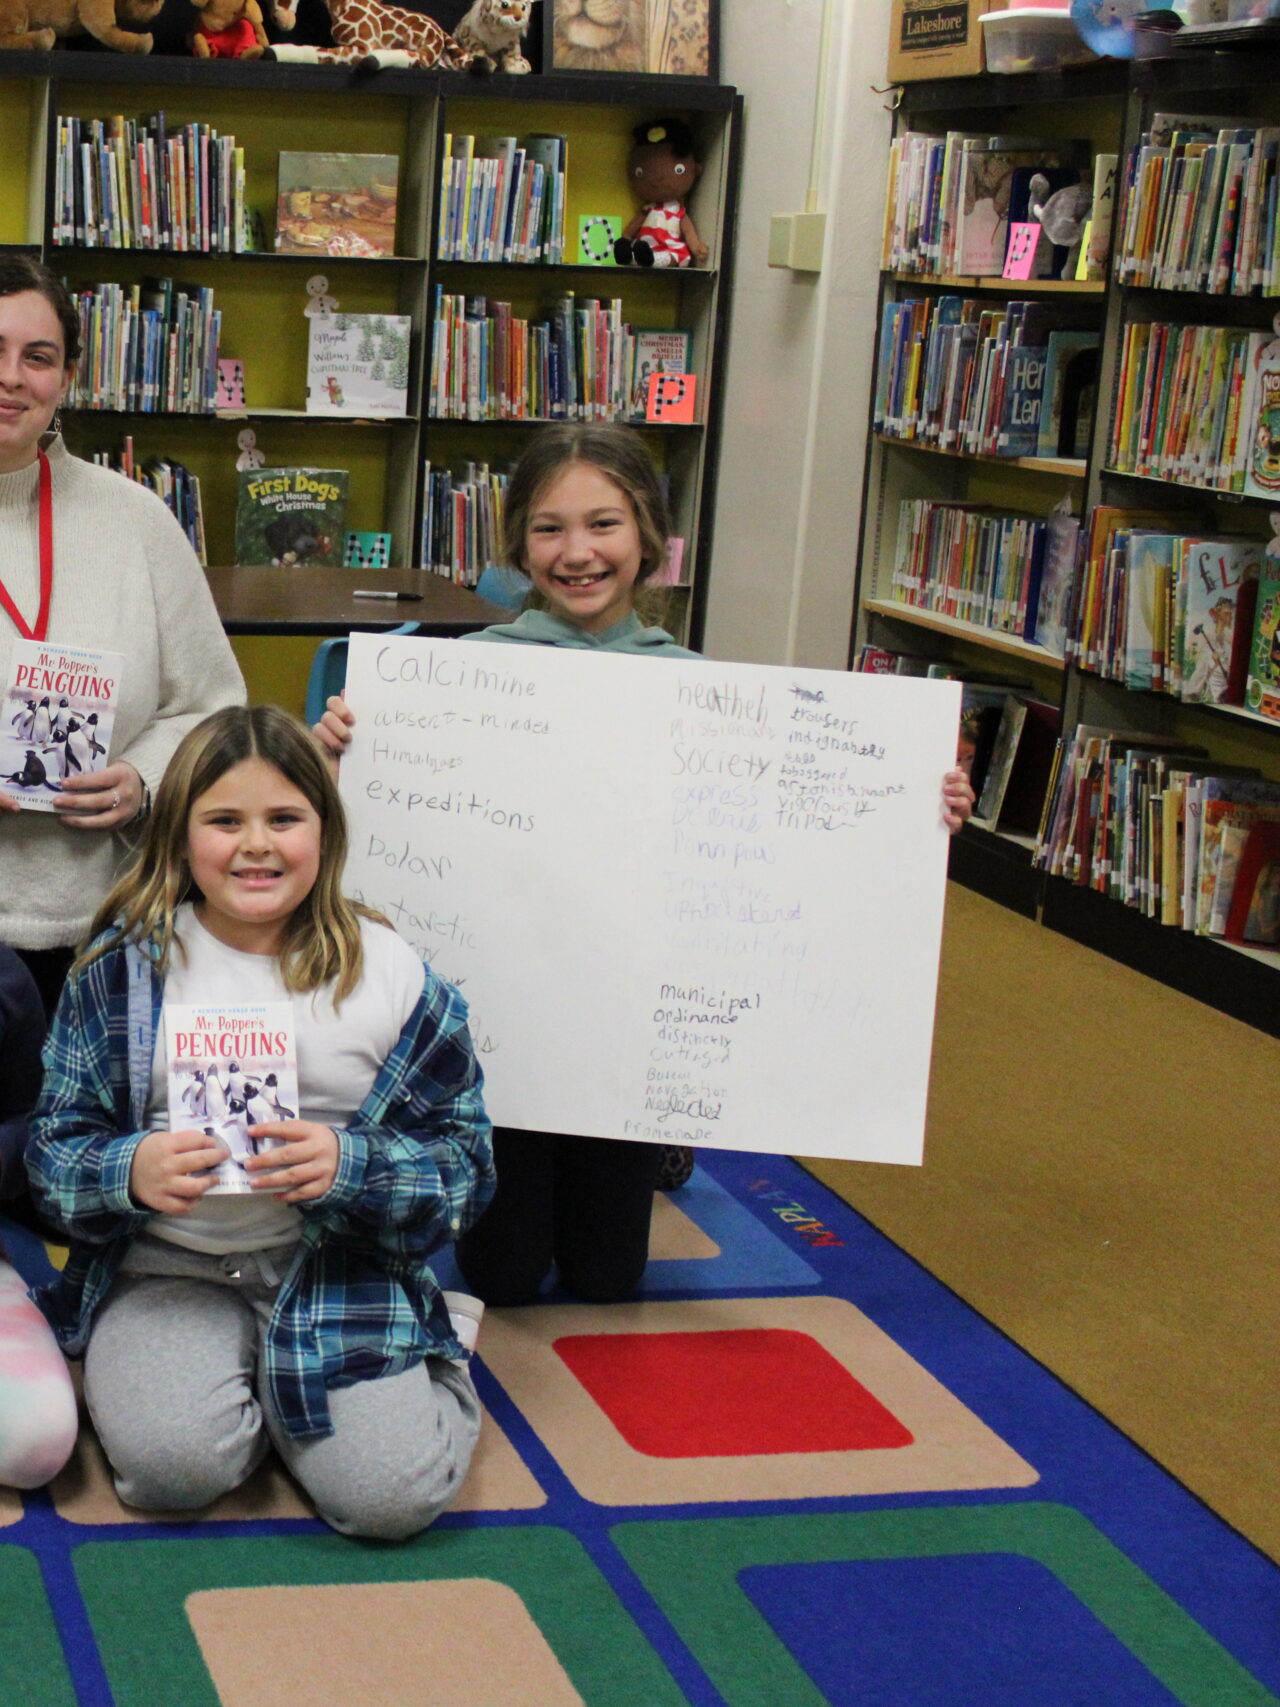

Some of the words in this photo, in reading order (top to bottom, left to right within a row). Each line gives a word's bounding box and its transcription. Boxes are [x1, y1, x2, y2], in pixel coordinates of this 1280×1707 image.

[907, 13, 962, 35] Lakeshore
[655, 376, 686, 417] P
[248, 477, 291, 500] First
[295, 475, 340, 502] Dog's
[260, 494, 284, 506] White
[286, 492, 312, 502] House
[276, 501, 327, 513] Christmas
[343, 534, 390, 568] M
[58, 656, 99, 675] Popper's
[872, 657, 889, 668] ON
[15, 664, 114, 700] PENGUINS
[366, 780, 535, 832] expeditions
[218, 1016, 265, 1033] Popper's
[175, 1032, 288, 1059] PENGUINS
